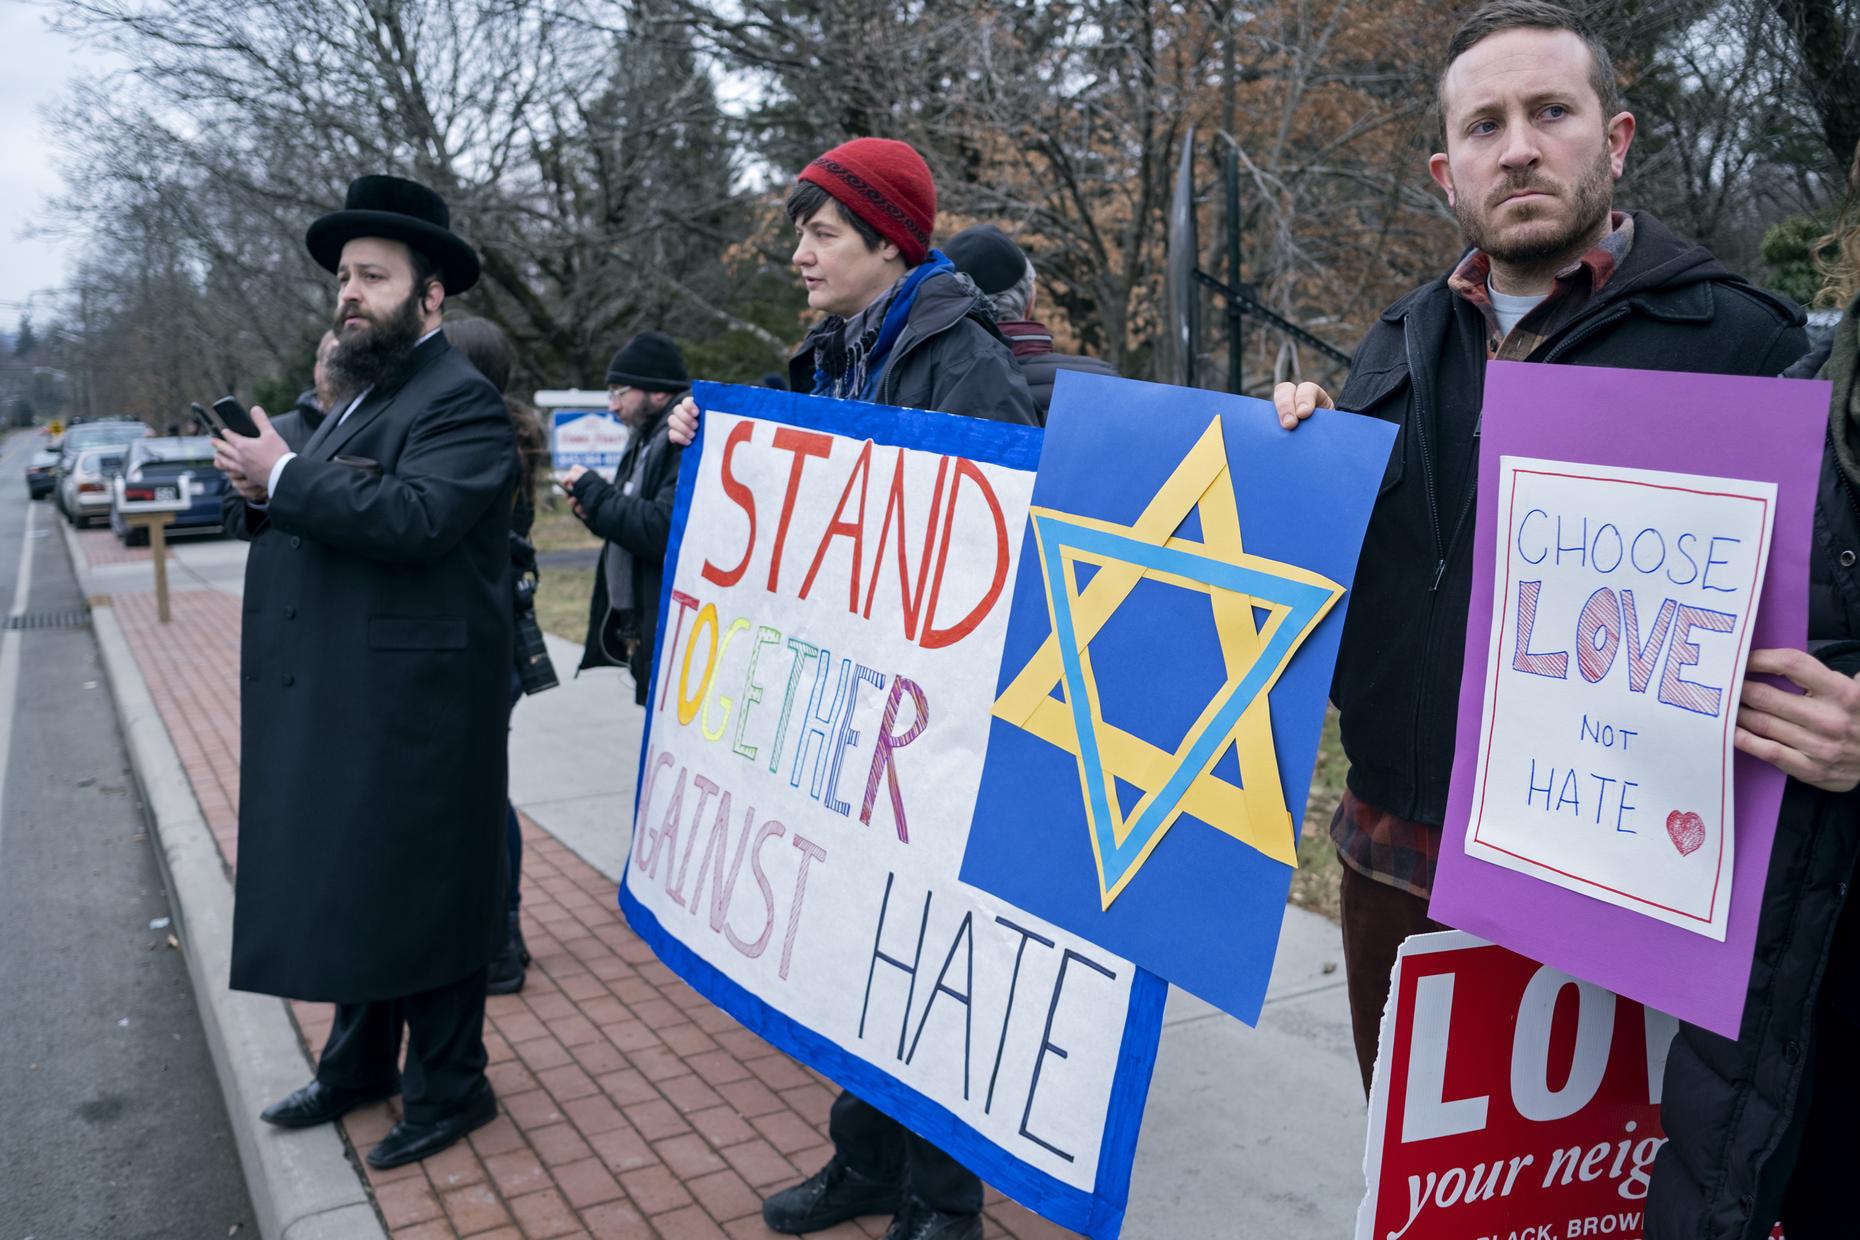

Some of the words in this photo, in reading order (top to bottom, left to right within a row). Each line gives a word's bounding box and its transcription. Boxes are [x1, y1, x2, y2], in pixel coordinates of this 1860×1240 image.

[701, 421, 1010, 649] STAND
[1518, 509, 1741, 592] CHOOSE
[1512, 580, 1737, 717] LOVE
[660, 590, 930, 844] TOGETHER
[1580, 714, 1639, 751] NOT
[1527, 759, 1639, 834] HATE
[859, 871, 1117, 1163] HATE
[1387, 1153, 1534, 1240] your
[1566, 1211, 1645, 1238] BROW
